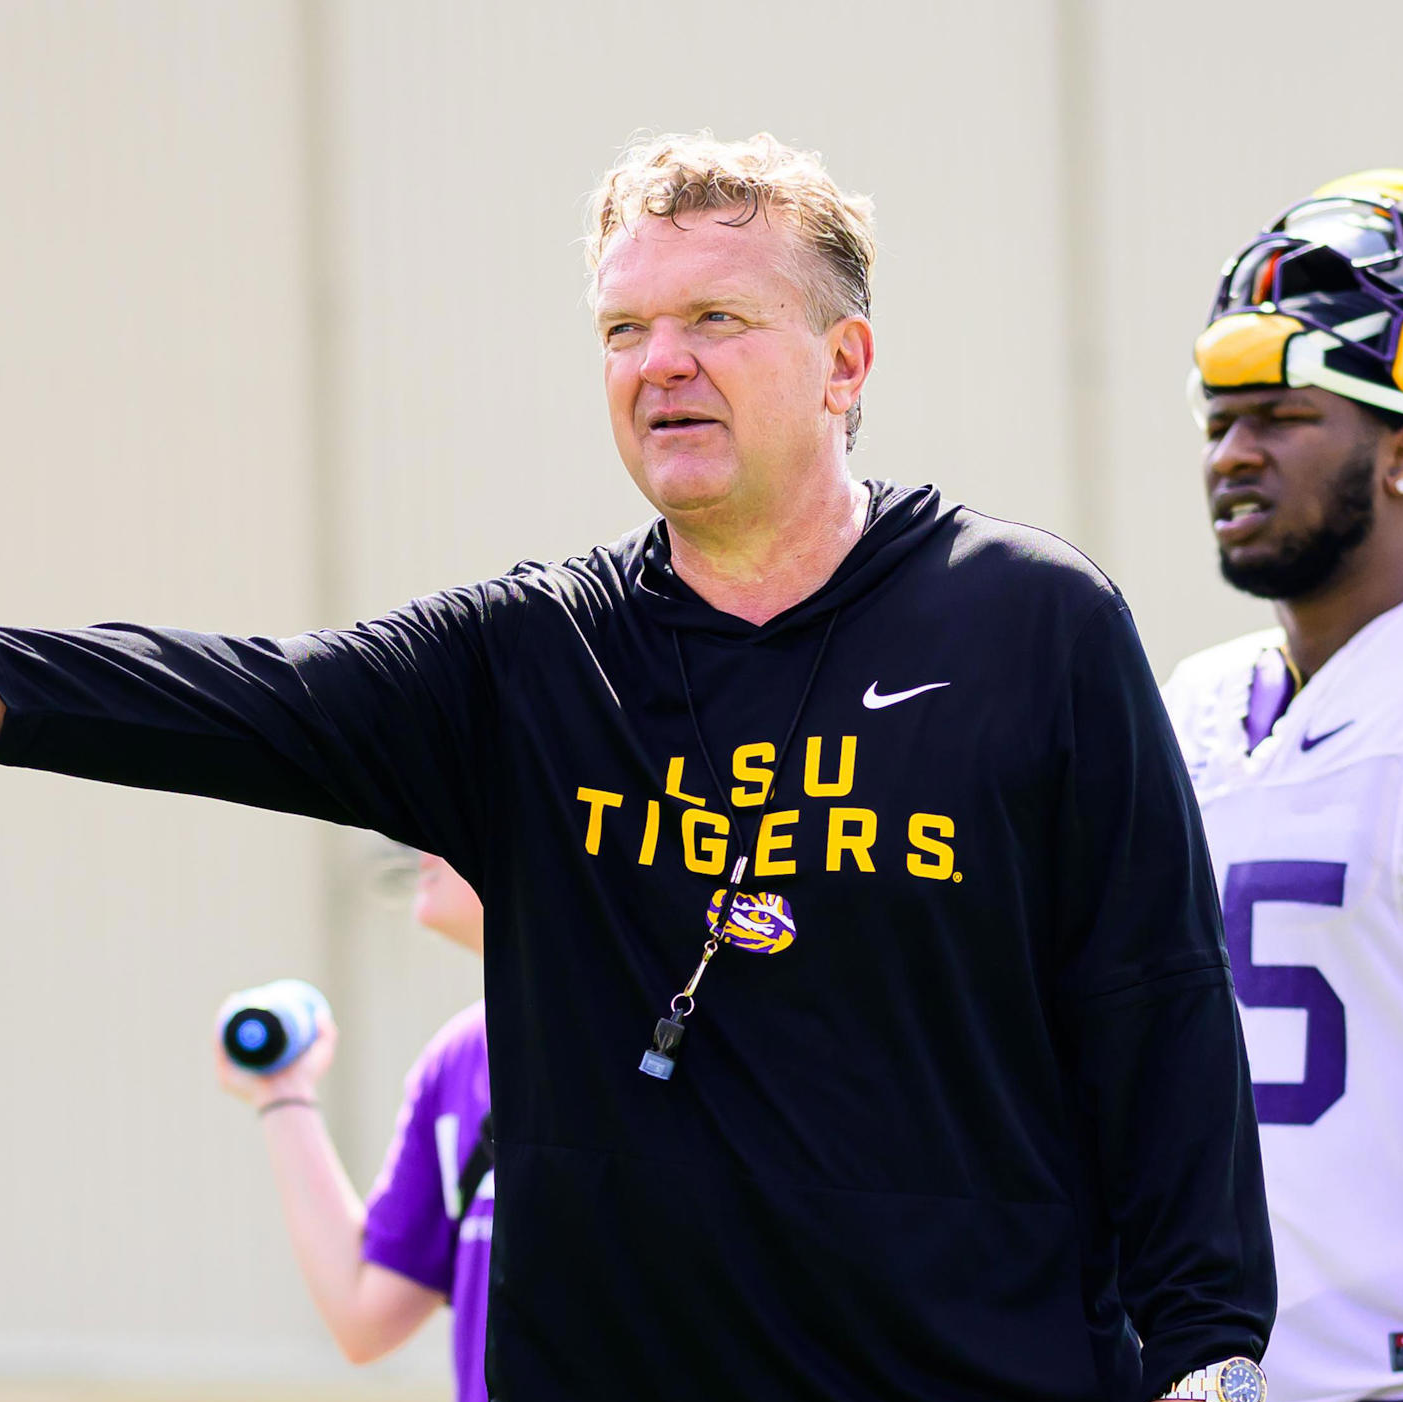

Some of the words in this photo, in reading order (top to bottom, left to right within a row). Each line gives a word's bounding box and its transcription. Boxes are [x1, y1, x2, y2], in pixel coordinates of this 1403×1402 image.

[665, 735, 858, 807] LSU
[576, 786, 956, 881] TIGERS
[1222, 860, 1347, 1126] 5
